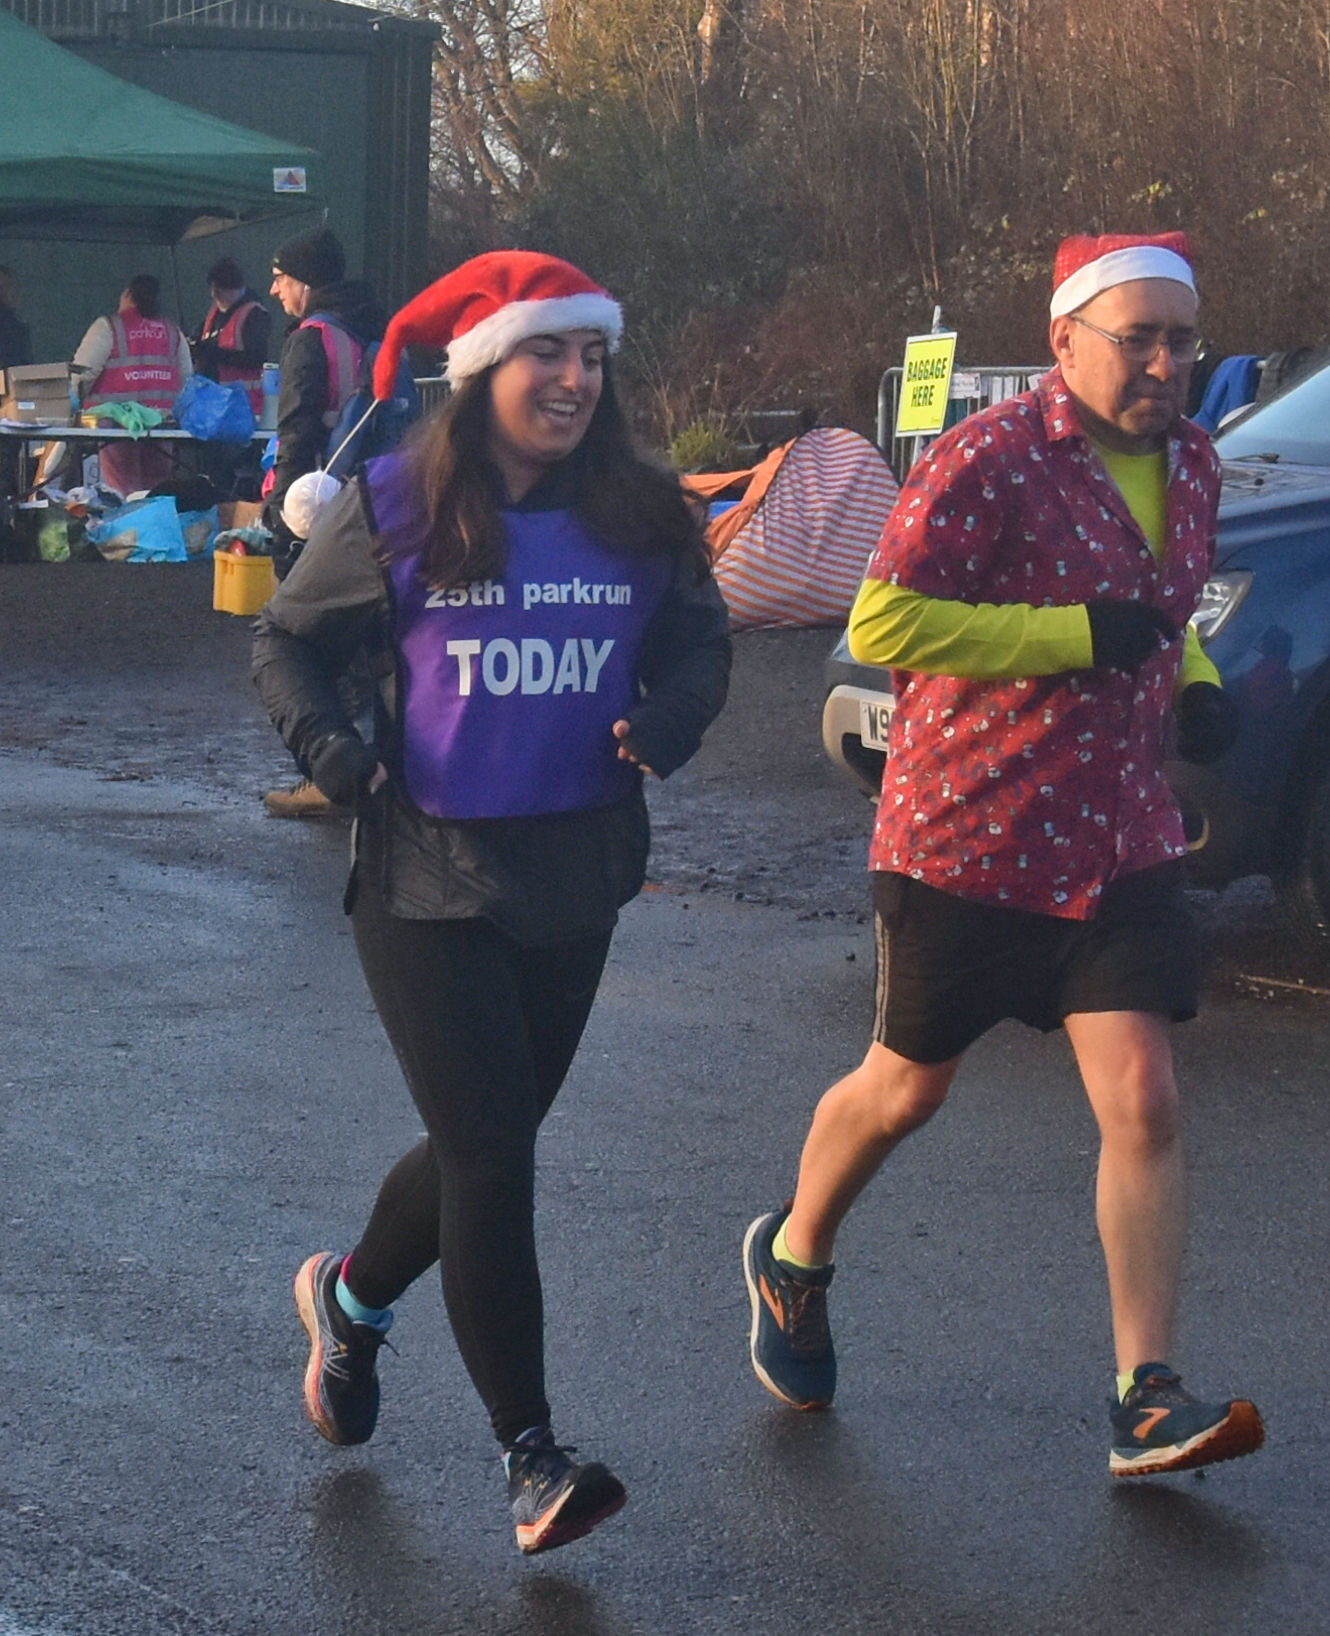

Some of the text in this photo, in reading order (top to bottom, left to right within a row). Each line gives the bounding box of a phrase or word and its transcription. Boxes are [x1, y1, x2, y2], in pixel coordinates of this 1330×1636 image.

[123, 370, 172, 381] VOLUNTEER
[906, 357, 948, 383] BAGGAGE
[910, 385, 936, 408] HERE
[523, 577, 632, 611] parkrun
[446, 637, 615, 696] TODAY
